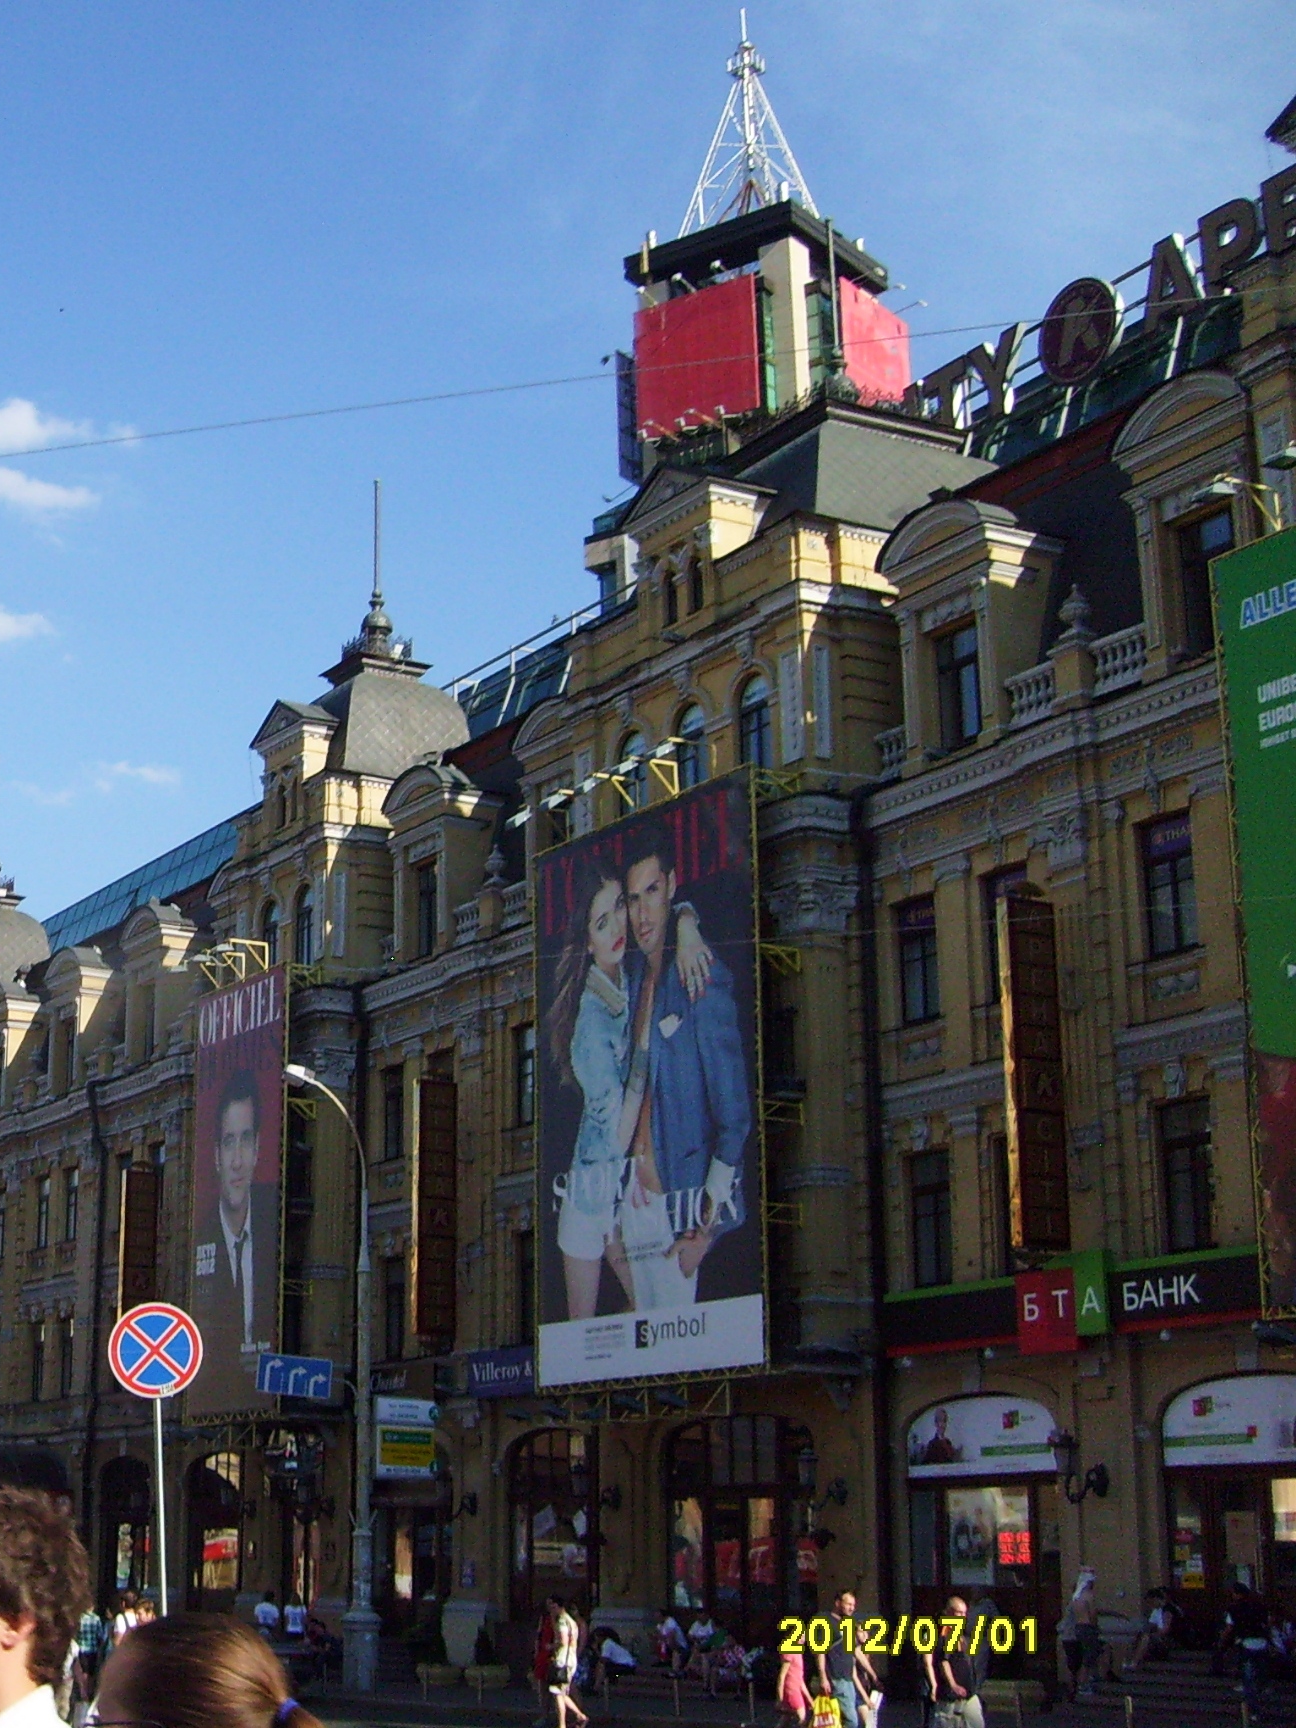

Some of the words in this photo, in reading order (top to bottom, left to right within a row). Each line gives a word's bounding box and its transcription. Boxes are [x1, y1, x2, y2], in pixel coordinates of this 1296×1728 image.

[1259, 702, 1296, 732] EURO
[1023, 1284, 1100, 1322] БТА
[1122, 1274, 1200, 1311] БАНК
[639, 1312, 706, 1346] symbol
[472, 1361, 520, 1383] Villeroy
